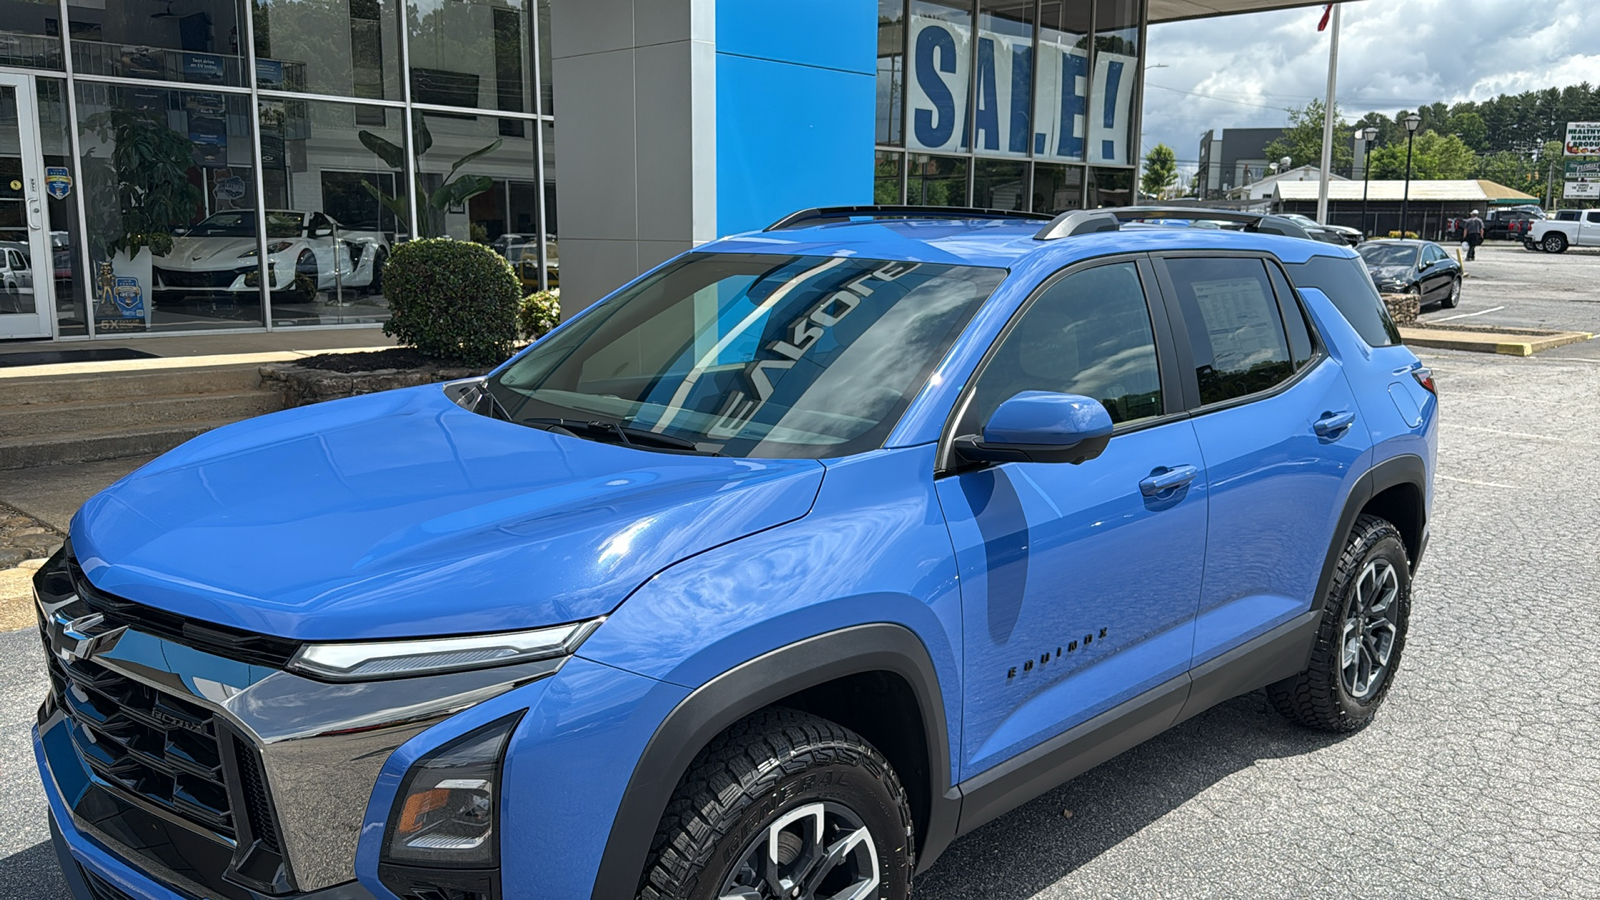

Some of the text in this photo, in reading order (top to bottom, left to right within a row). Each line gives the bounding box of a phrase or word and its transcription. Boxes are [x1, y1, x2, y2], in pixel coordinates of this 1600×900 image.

[914, 25, 1125, 160] SALE!
[1007, 627, 1107, 679] EQUINOX
[723, 768, 850, 864] GENERAL
